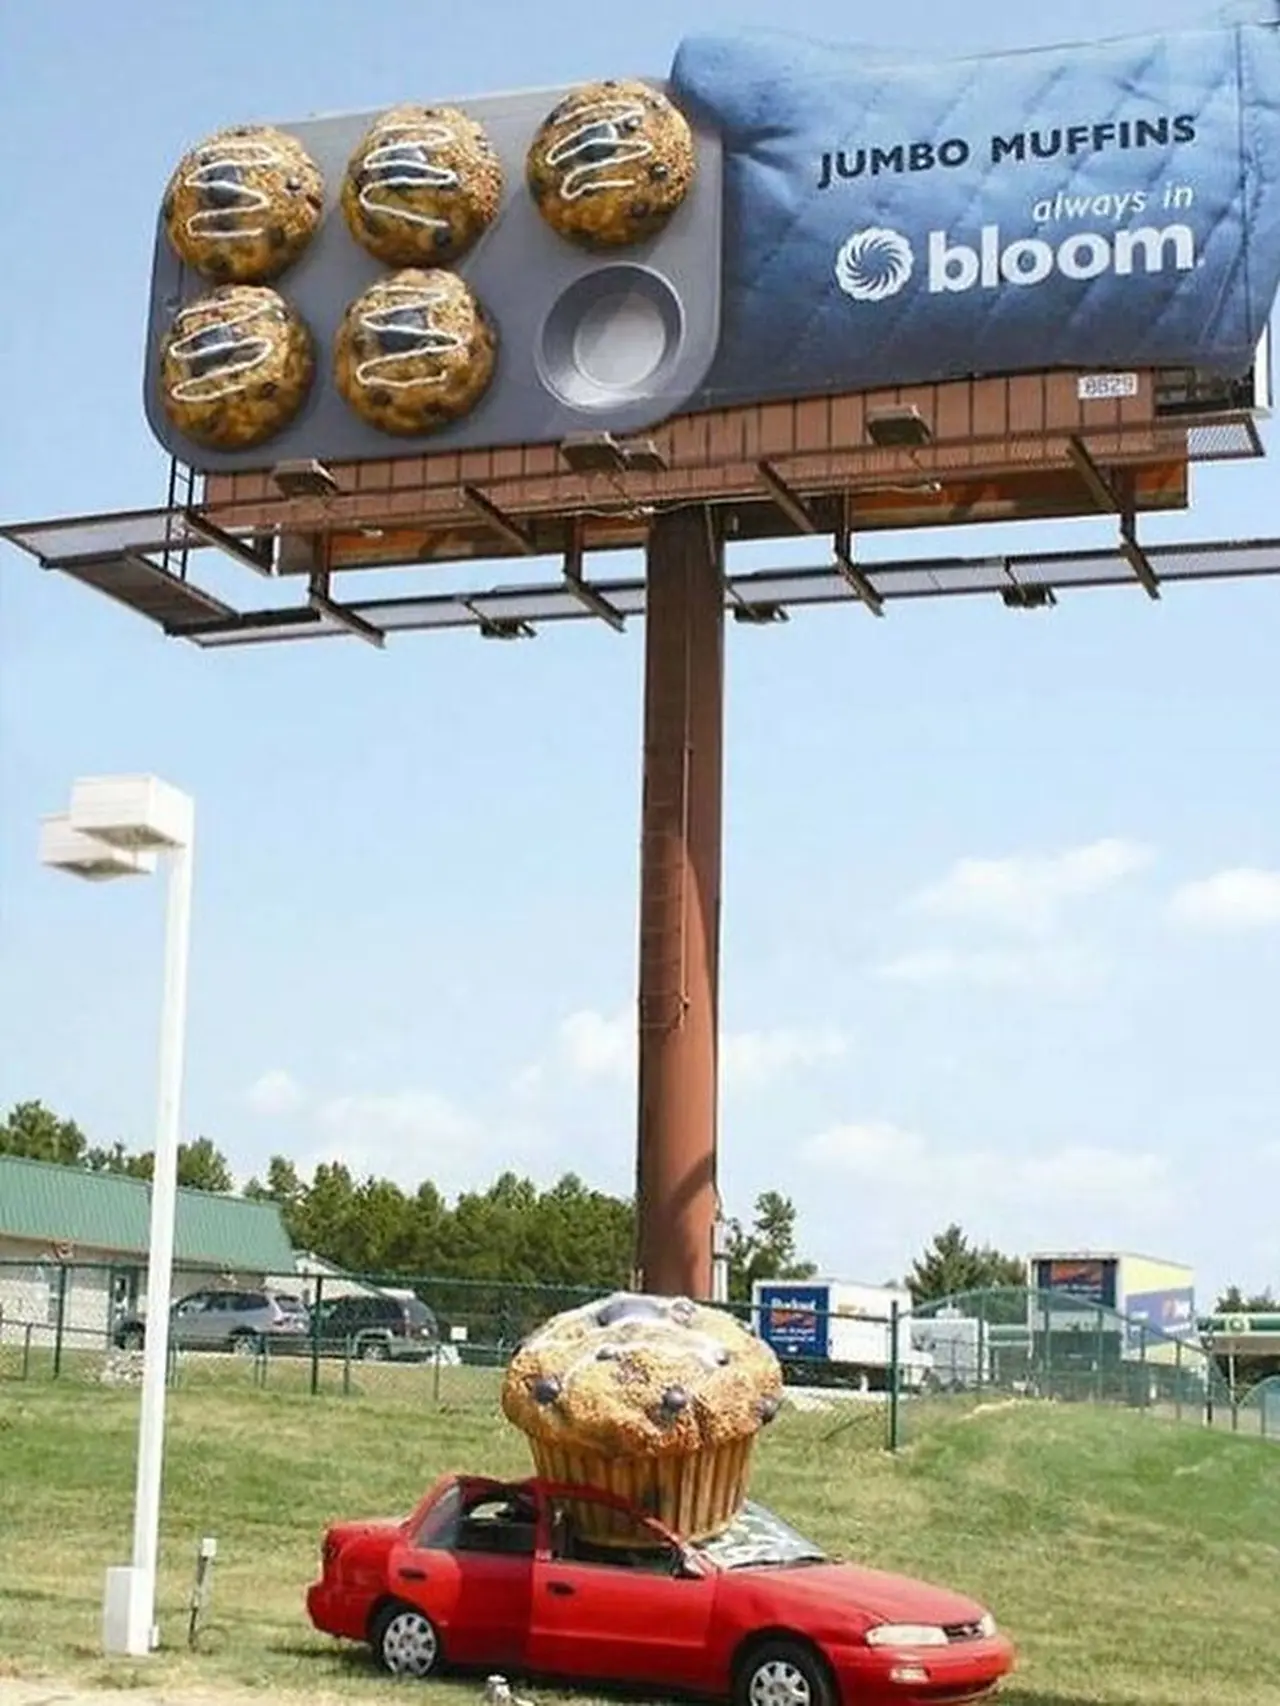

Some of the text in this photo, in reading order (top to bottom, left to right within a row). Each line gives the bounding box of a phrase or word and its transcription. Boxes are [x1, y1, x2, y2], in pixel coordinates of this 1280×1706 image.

[817, 115, 1196, 189] JUMBO MUFFINS
[1032, 181, 1194, 224] always in
[928, 223, 1195, 293] bloom
